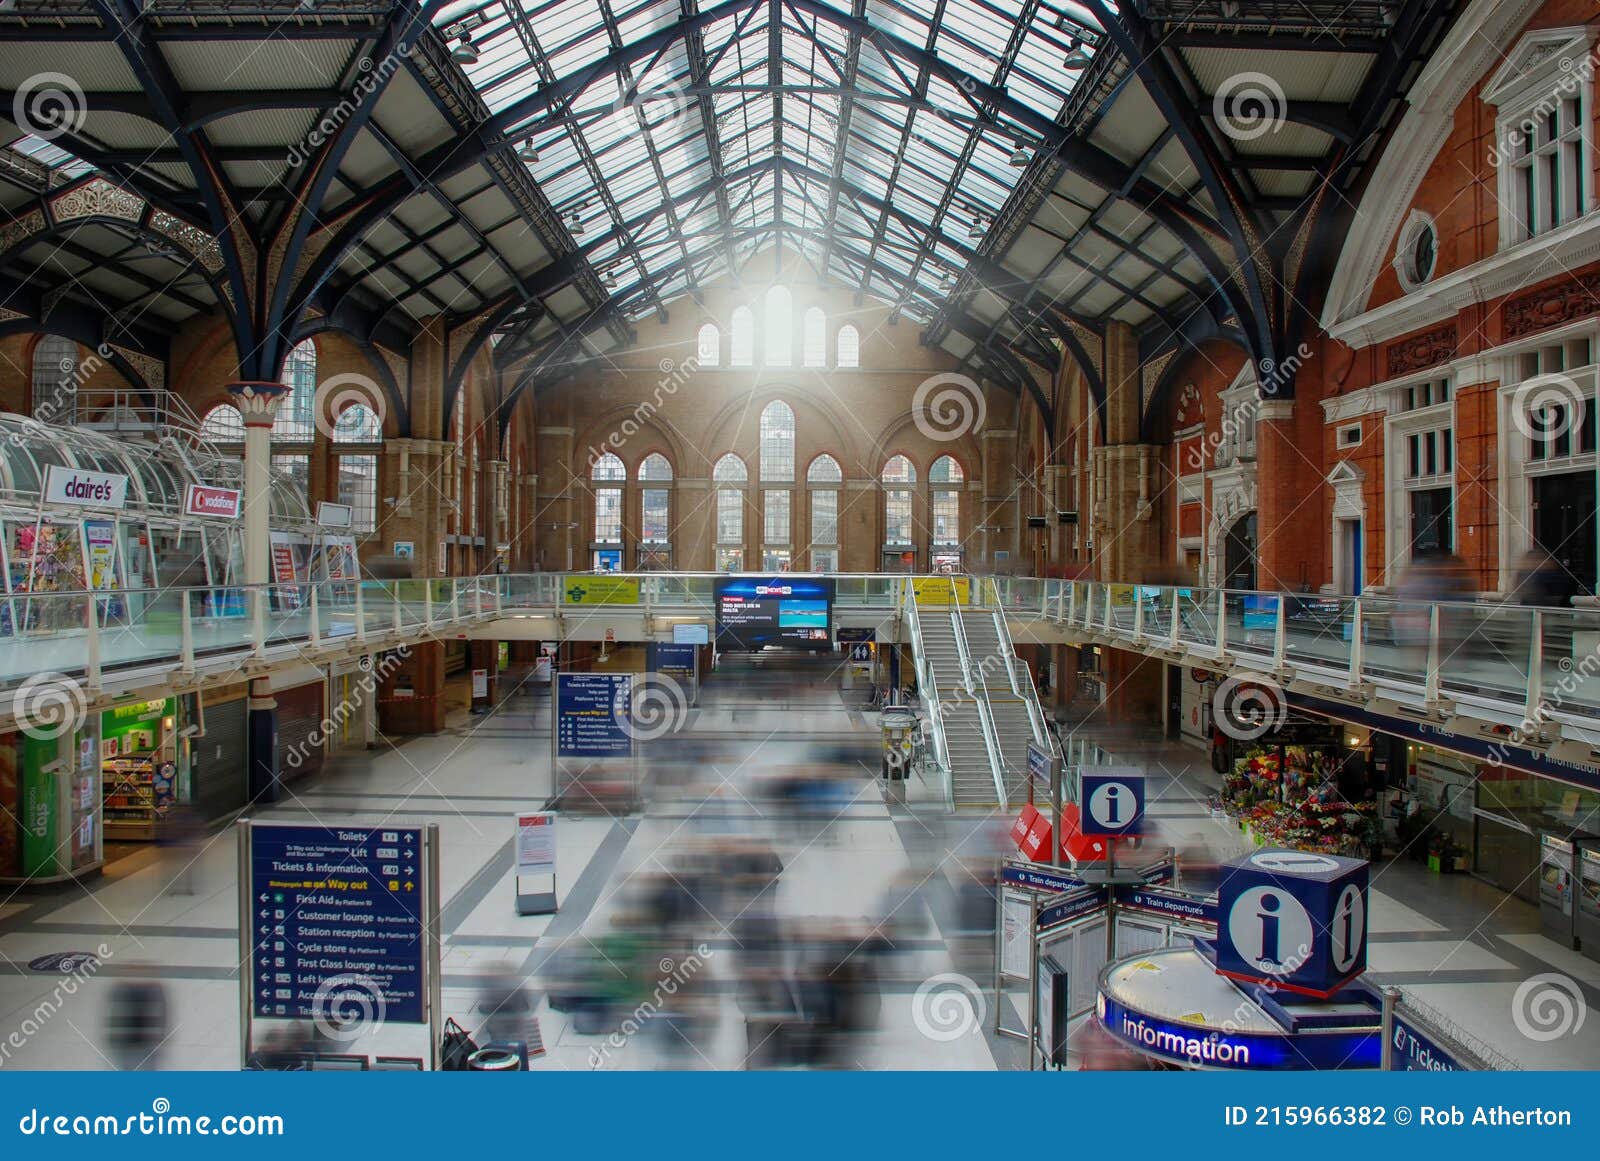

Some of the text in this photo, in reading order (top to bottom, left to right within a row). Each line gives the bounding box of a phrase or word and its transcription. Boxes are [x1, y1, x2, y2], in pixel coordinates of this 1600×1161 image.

[64, 476, 112, 500] claire's
[205, 495, 235, 509] vodafone
[31, 803, 51, 837] stop
[338, 831, 368, 842] Toilets
[351, 848, 368, 857] Lift
[272, 861, 368, 874] Tickets & information
[328, 879, 349, 891] Way
[350, 880, 368, 890] out
[1028, 875, 1043, 884] Train
[296, 894, 316, 904] First
[318, 895, 334, 905] Aid
[1146, 897, 1204, 916] Train departures
[297, 910, 341, 921] Customer
[343, 912, 374, 924] lounge
[298, 926, 331, 937] Station
[332, 928, 375, 939] reception
[297, 942, 321, 954] Cycle
[323, 943, 347, 953] store
[297, 958, 318, 968] First
[319, 958, 343, 969] Class
[345, 959, 376, 972] lounge
[298, 974, 316, 984] Left
[318, 975, 354, 987] luggage
[298, 990, 346, 1001] Accessible
[347, 991, 375, 1002] toilets
[1123, 1014, 1250, 1064] information
[1408, 1034, 1454, 1071] Ticket
